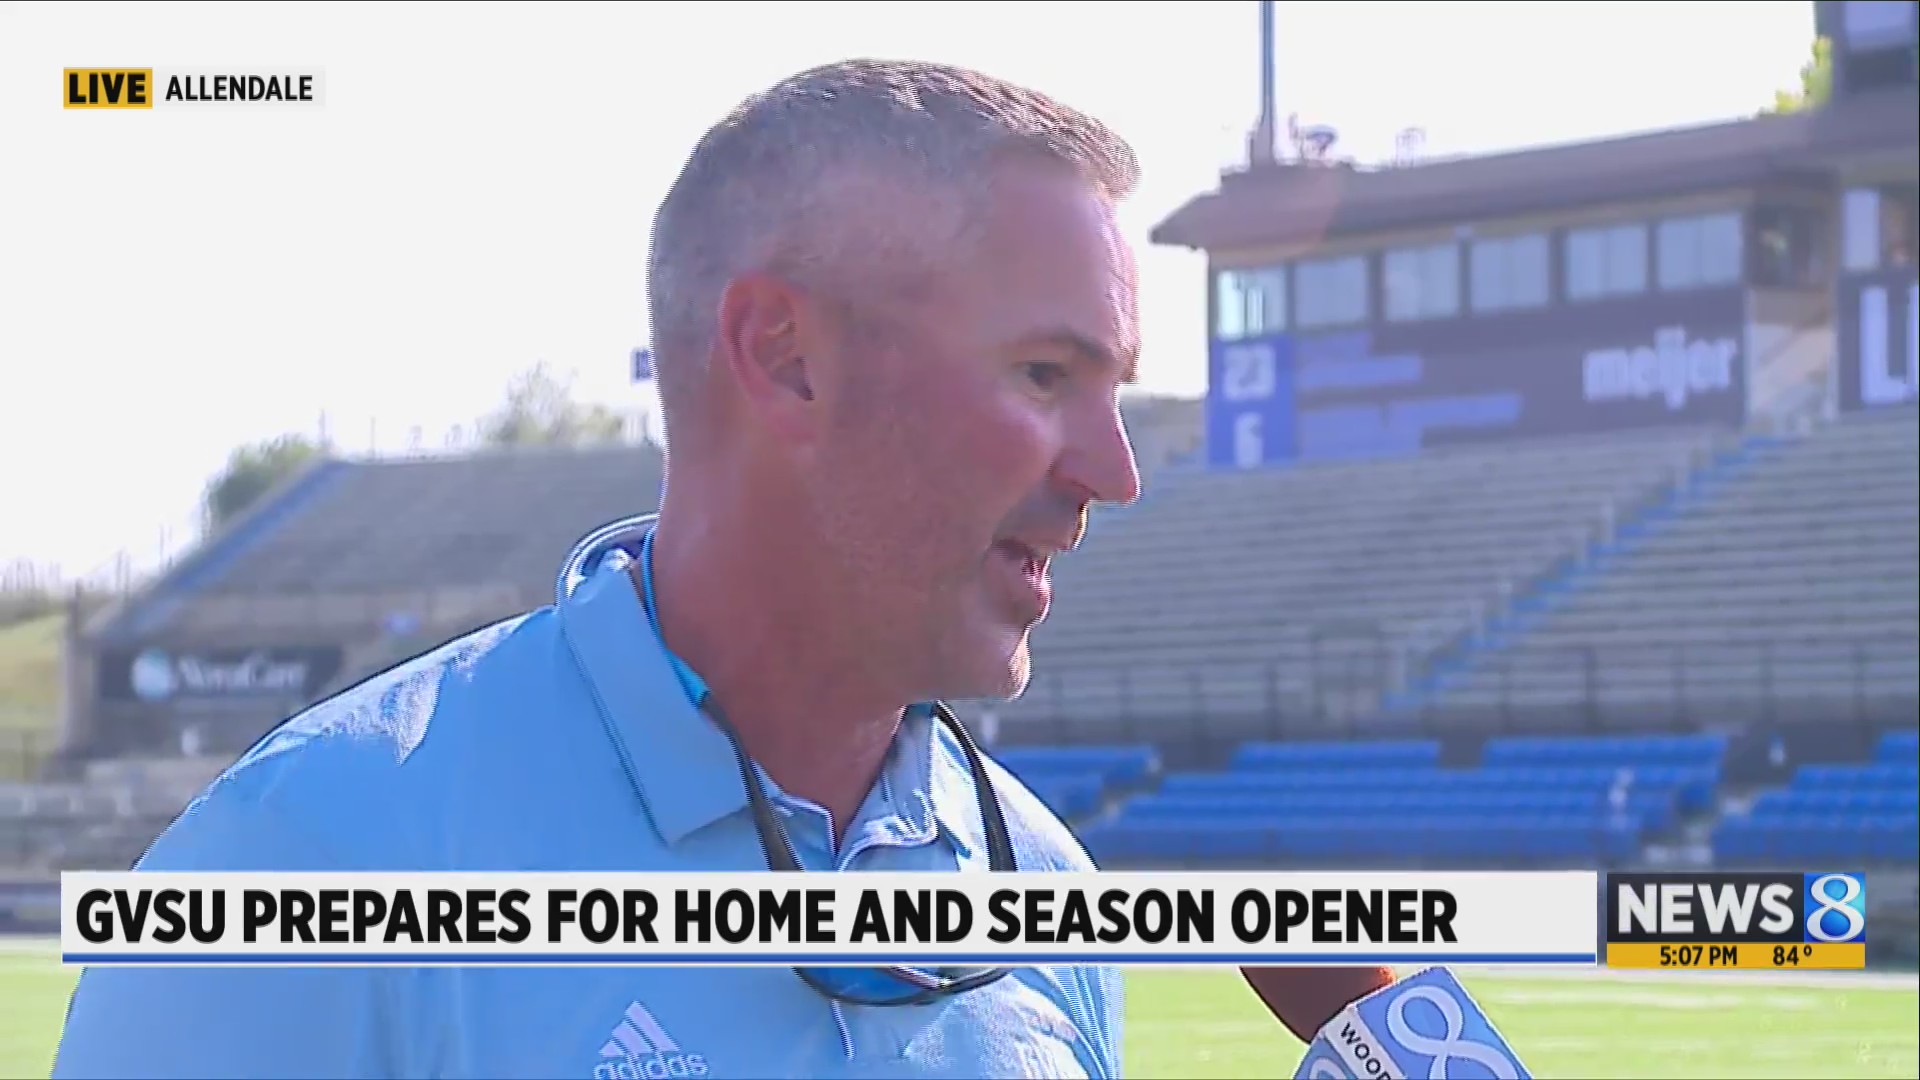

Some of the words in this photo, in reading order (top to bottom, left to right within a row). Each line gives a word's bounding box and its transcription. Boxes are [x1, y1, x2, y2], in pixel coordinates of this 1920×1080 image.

[1223, 344, 1275, 400] 23
[1582, 325, 1737, 410] meijer
[1234, 413, 1263, 469] 6
[593, 1052, 709, 1080] adidas
